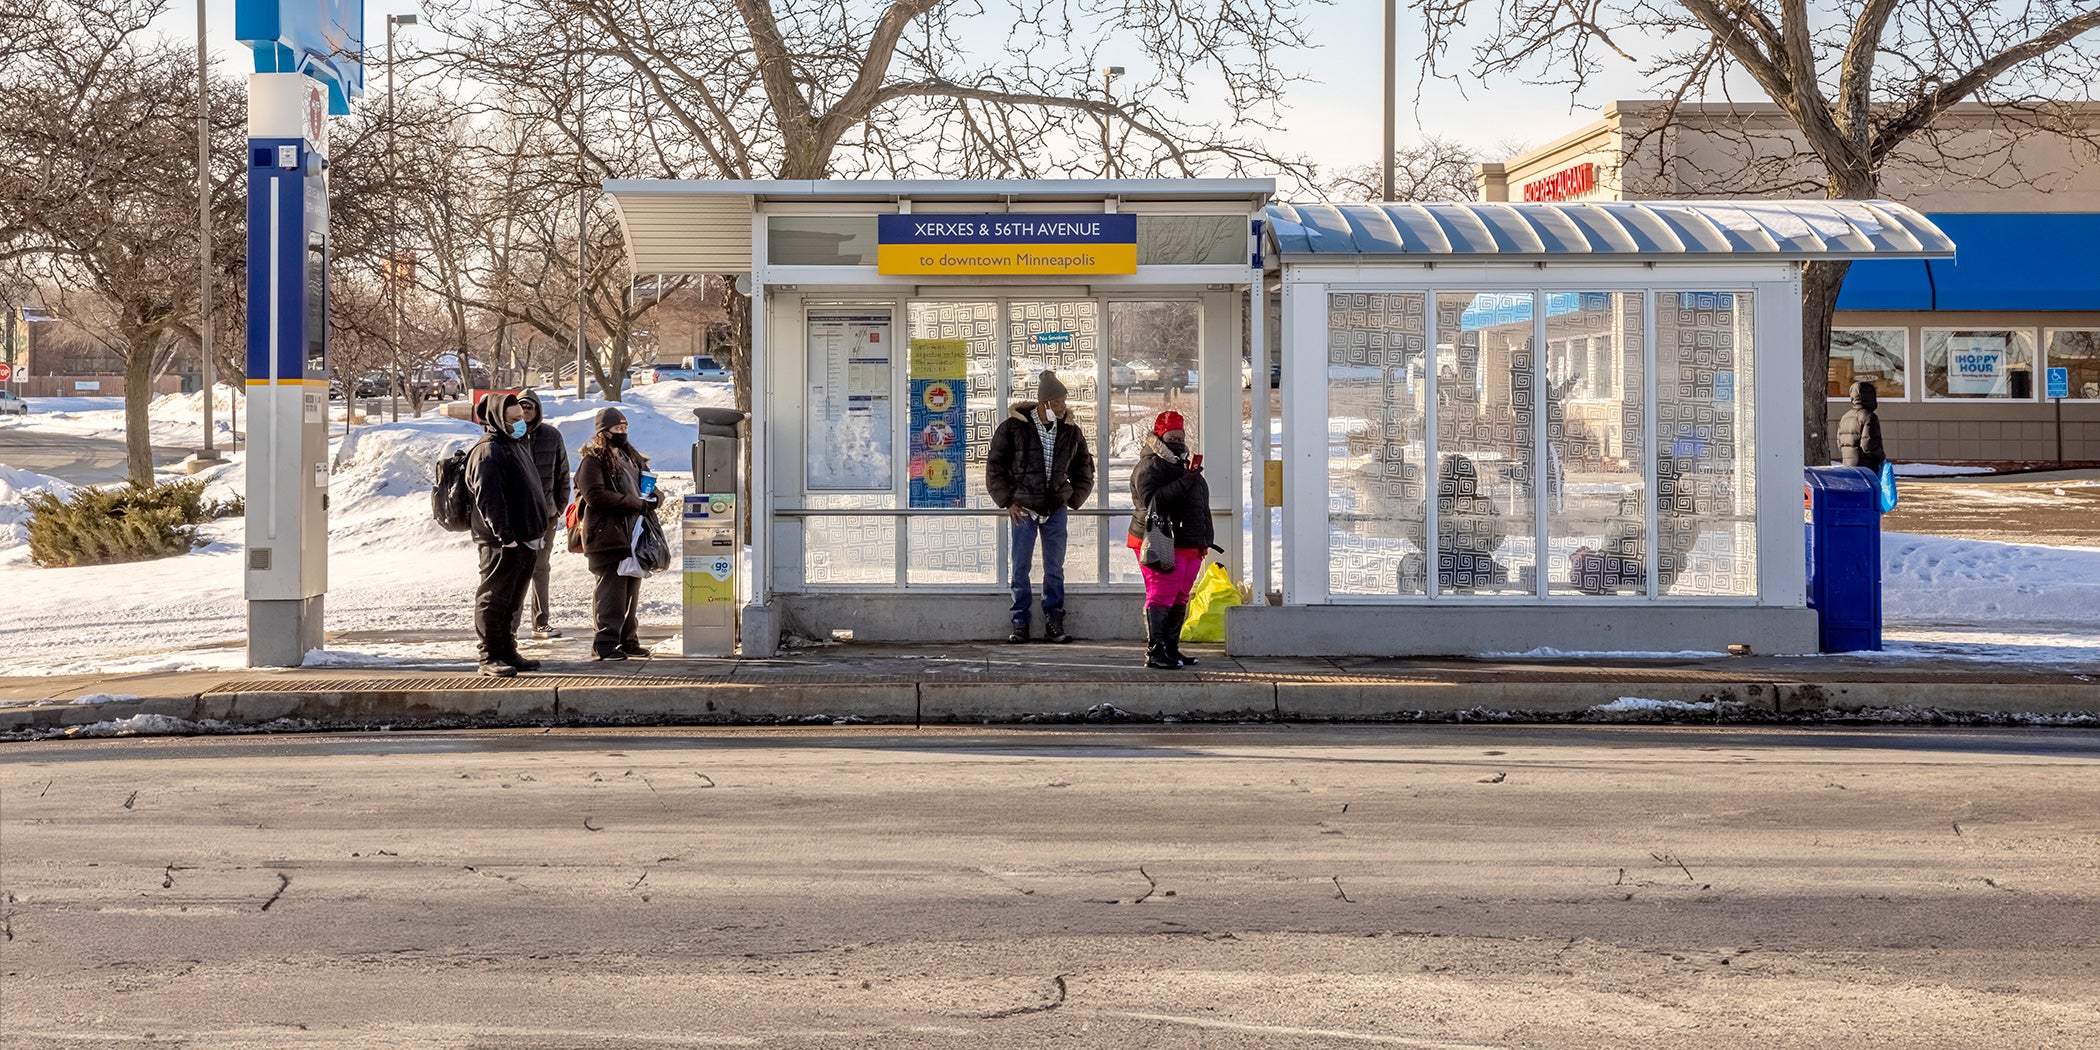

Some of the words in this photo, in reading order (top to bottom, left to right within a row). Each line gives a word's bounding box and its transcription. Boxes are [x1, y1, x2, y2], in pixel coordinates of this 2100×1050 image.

[1540, 163, 1594, 202] RESTAURANT
[914, 223, 974, 236] XERXES
[978, 223, 990, 236] &
[994, 223, 1034, 236] 56TH
[1037, 223, 1101, 236] AVENUE
[919, 255, 935, 266] to
[939, 254, 1011, 266] downtown
[1016, 253, 1096, 269] Minneapolis
[1955, 355, 1999, 364] IHOPPY
[1960, 363, 1993, 373] HOUR
[715, 562, 728, 571] go
